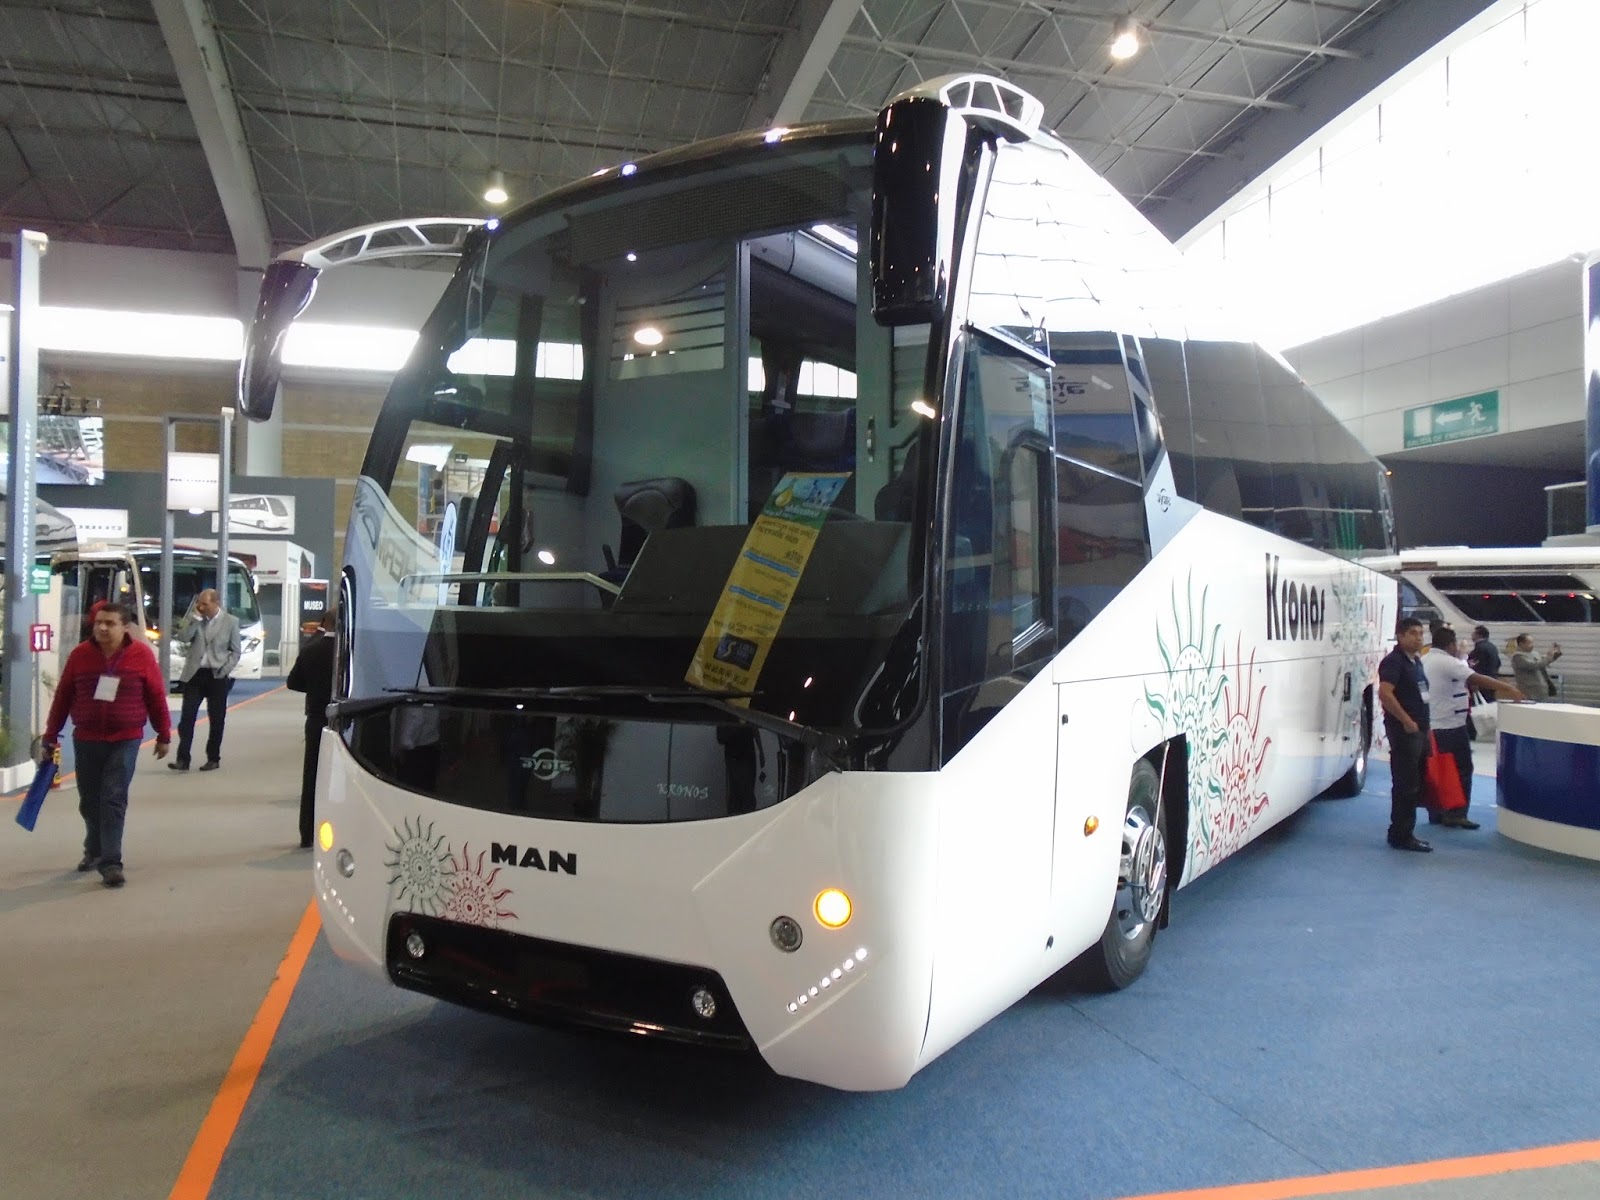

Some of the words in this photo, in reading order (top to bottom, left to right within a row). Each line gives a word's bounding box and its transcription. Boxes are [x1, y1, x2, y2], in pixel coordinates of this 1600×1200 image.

[303, 600, 324, 611] MUSEO
[1265, 552, 1325, 642] Kronos
[656, 783, 709, 800] KRONOS
[491, 842, 577, 876] MAN
